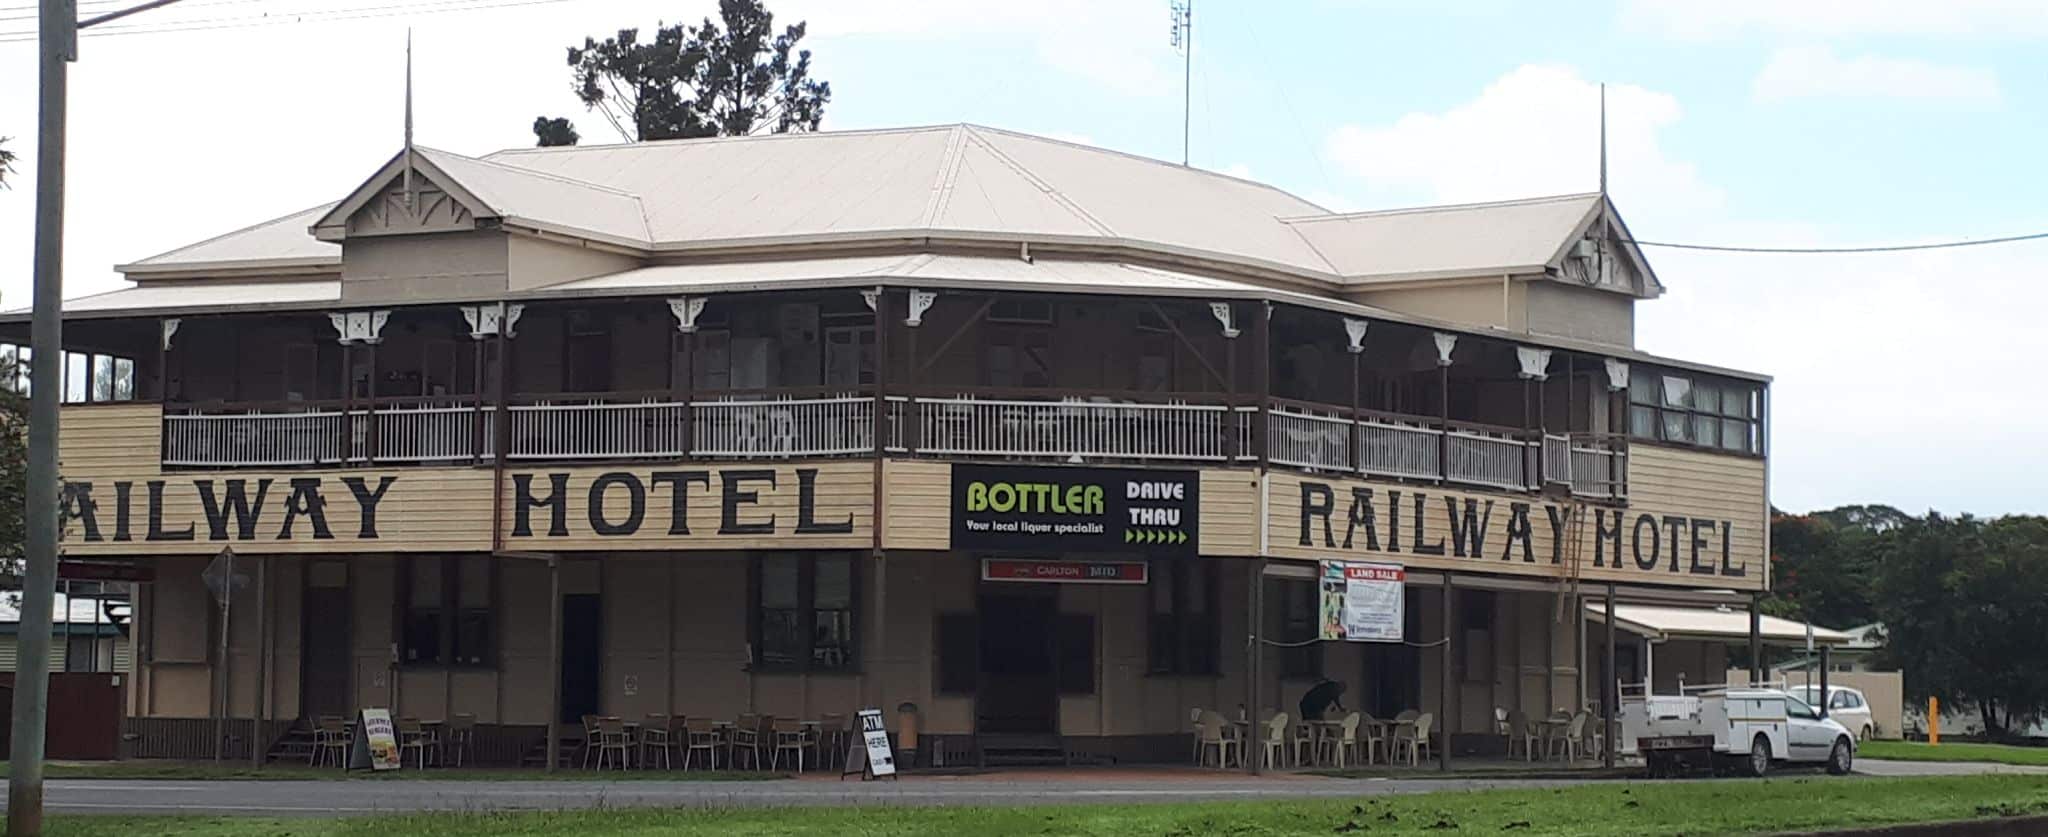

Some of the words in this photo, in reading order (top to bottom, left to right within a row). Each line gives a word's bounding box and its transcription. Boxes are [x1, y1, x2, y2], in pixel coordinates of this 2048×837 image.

[967, 481, 1104, 515] BOTTLER
[1126, 481, 1184, 500] DRIVE
[58, 476, 398, 542] AILWAY
[511, 468, 854, 537] HOTEL
[1128, 507, 1181, 526] THRU
[966, 519, 990, 531] Your
[992, 520, 1019, 533] local
[1021, 522, 1052, 535] liquor
[1054, 523, 1104, 536] specialist
[1299, 480, 1572, 565] RAILWAY
[1593, 508, 1746, 577] HOTEL
[1036, 565, 1080, 576] CARLTON
[1089, 565, 1117, 578] MID
[1351, 568, 1375, 578] LAND
[1376, 569, 1398, 580] SALE
[863, 715, 884, 731] ATM
